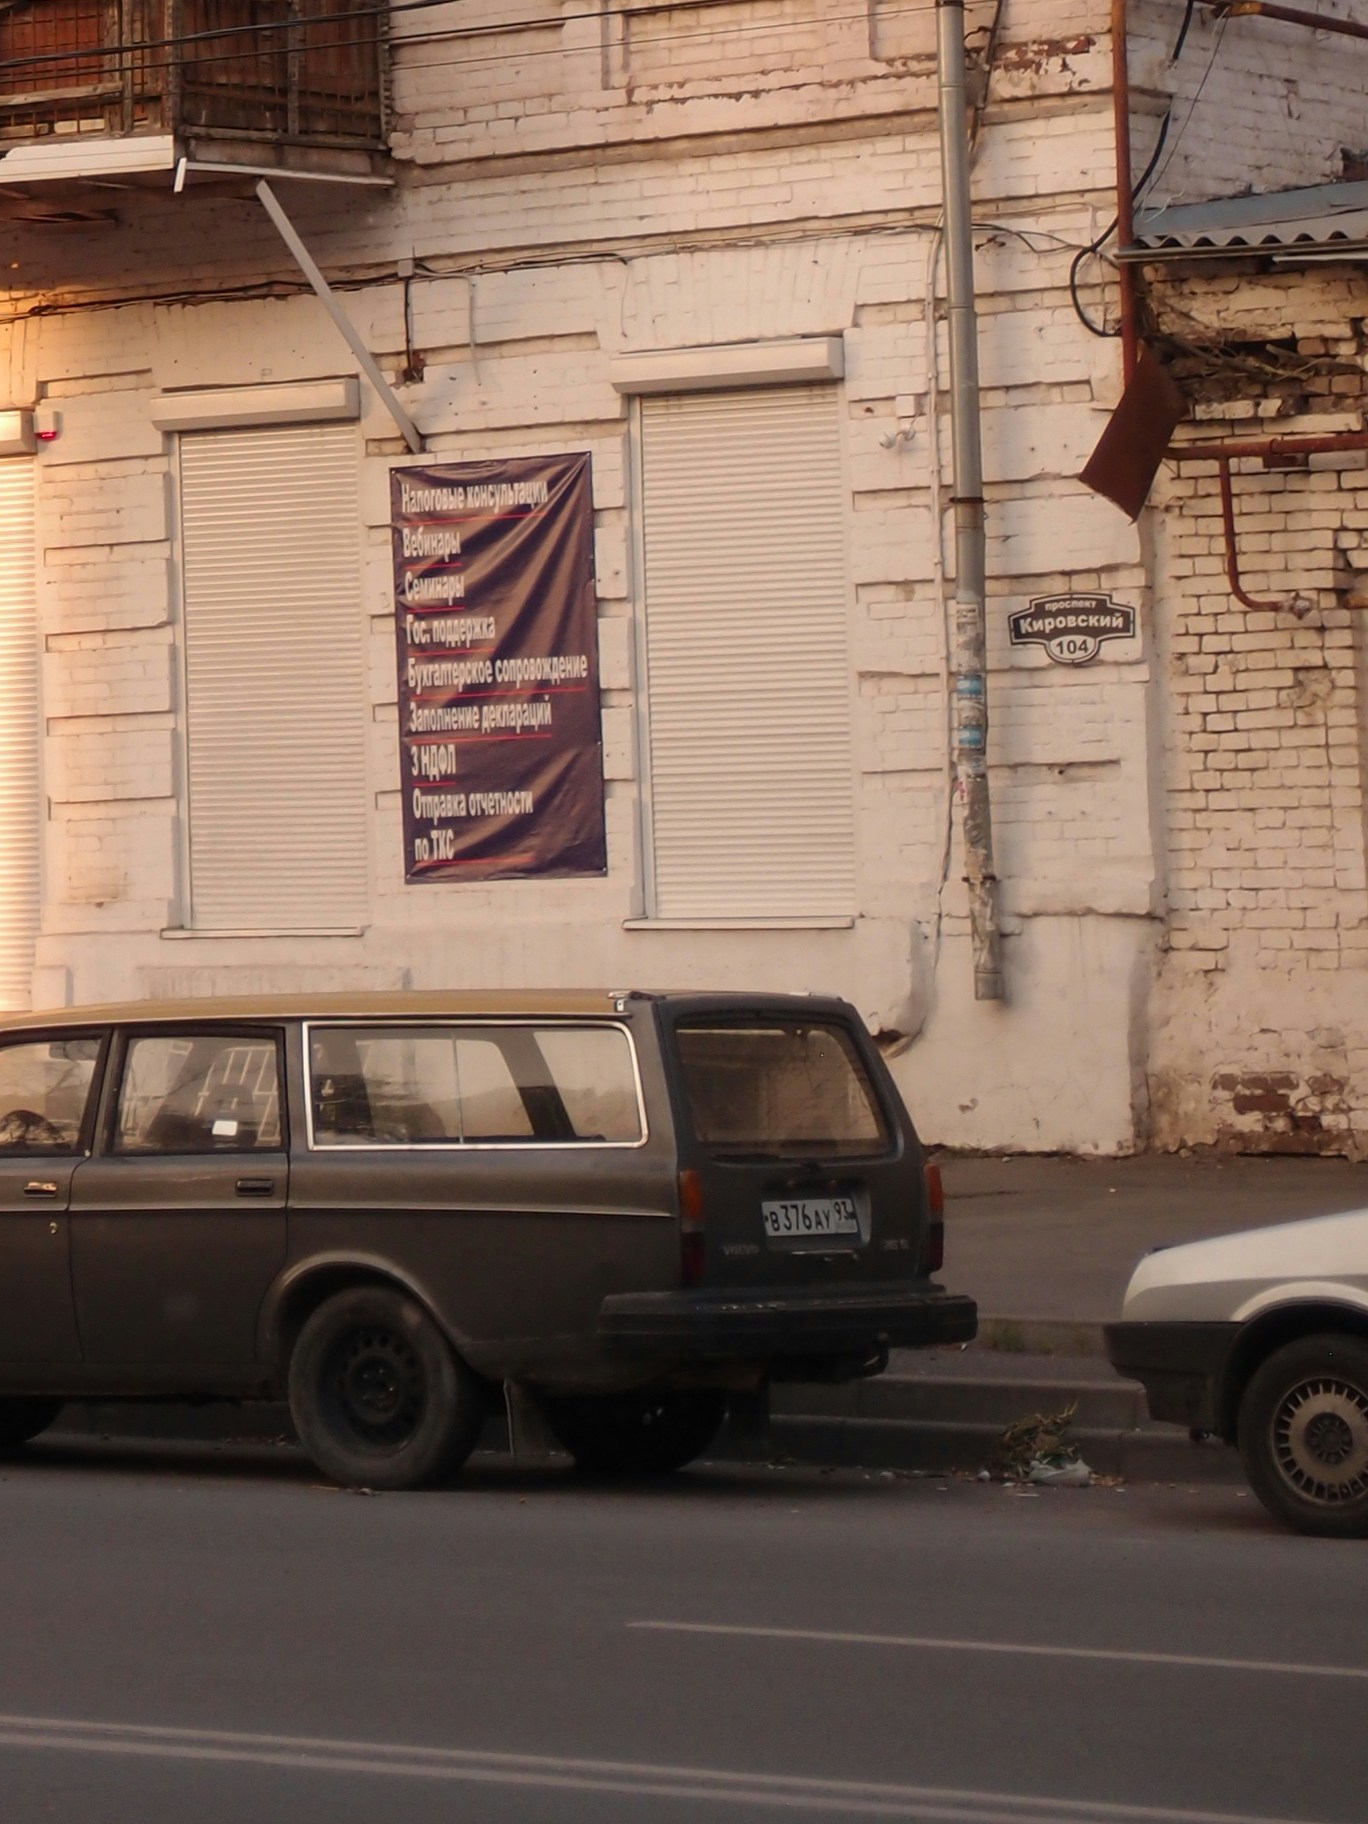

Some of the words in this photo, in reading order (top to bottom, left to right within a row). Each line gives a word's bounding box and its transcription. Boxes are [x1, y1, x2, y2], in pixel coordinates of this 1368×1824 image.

[402, 483, 465, 513] Налоговые
[466, 481, 548, 514] консультации
[403, 526, 461, 562] Вебинары
[404, 571, 465, 605] Семинары
[1044, 600, 1097, 612] проспект
[405, 615, 431, 644] Гос.
[433, 616, 496, 648] поддержка
[1019, 613, 1124, 634] Кировский
[1055, 639, 1089, 654] 104
[408, 658, 493, 694] Бухгалтерское
[495, 654, 588, 689] сопровождение
[410, 702, 480, 732] Заполнение
[482, 694, 552, 734] деклараций
[421, 744, 456, 781] НДФЛ
[413, 788, 467, 825] Отправка
[469, 790, 534, 816] отчетности
[414, 837, 429, 861] по
[430, 829, 455, 860] ТКС
